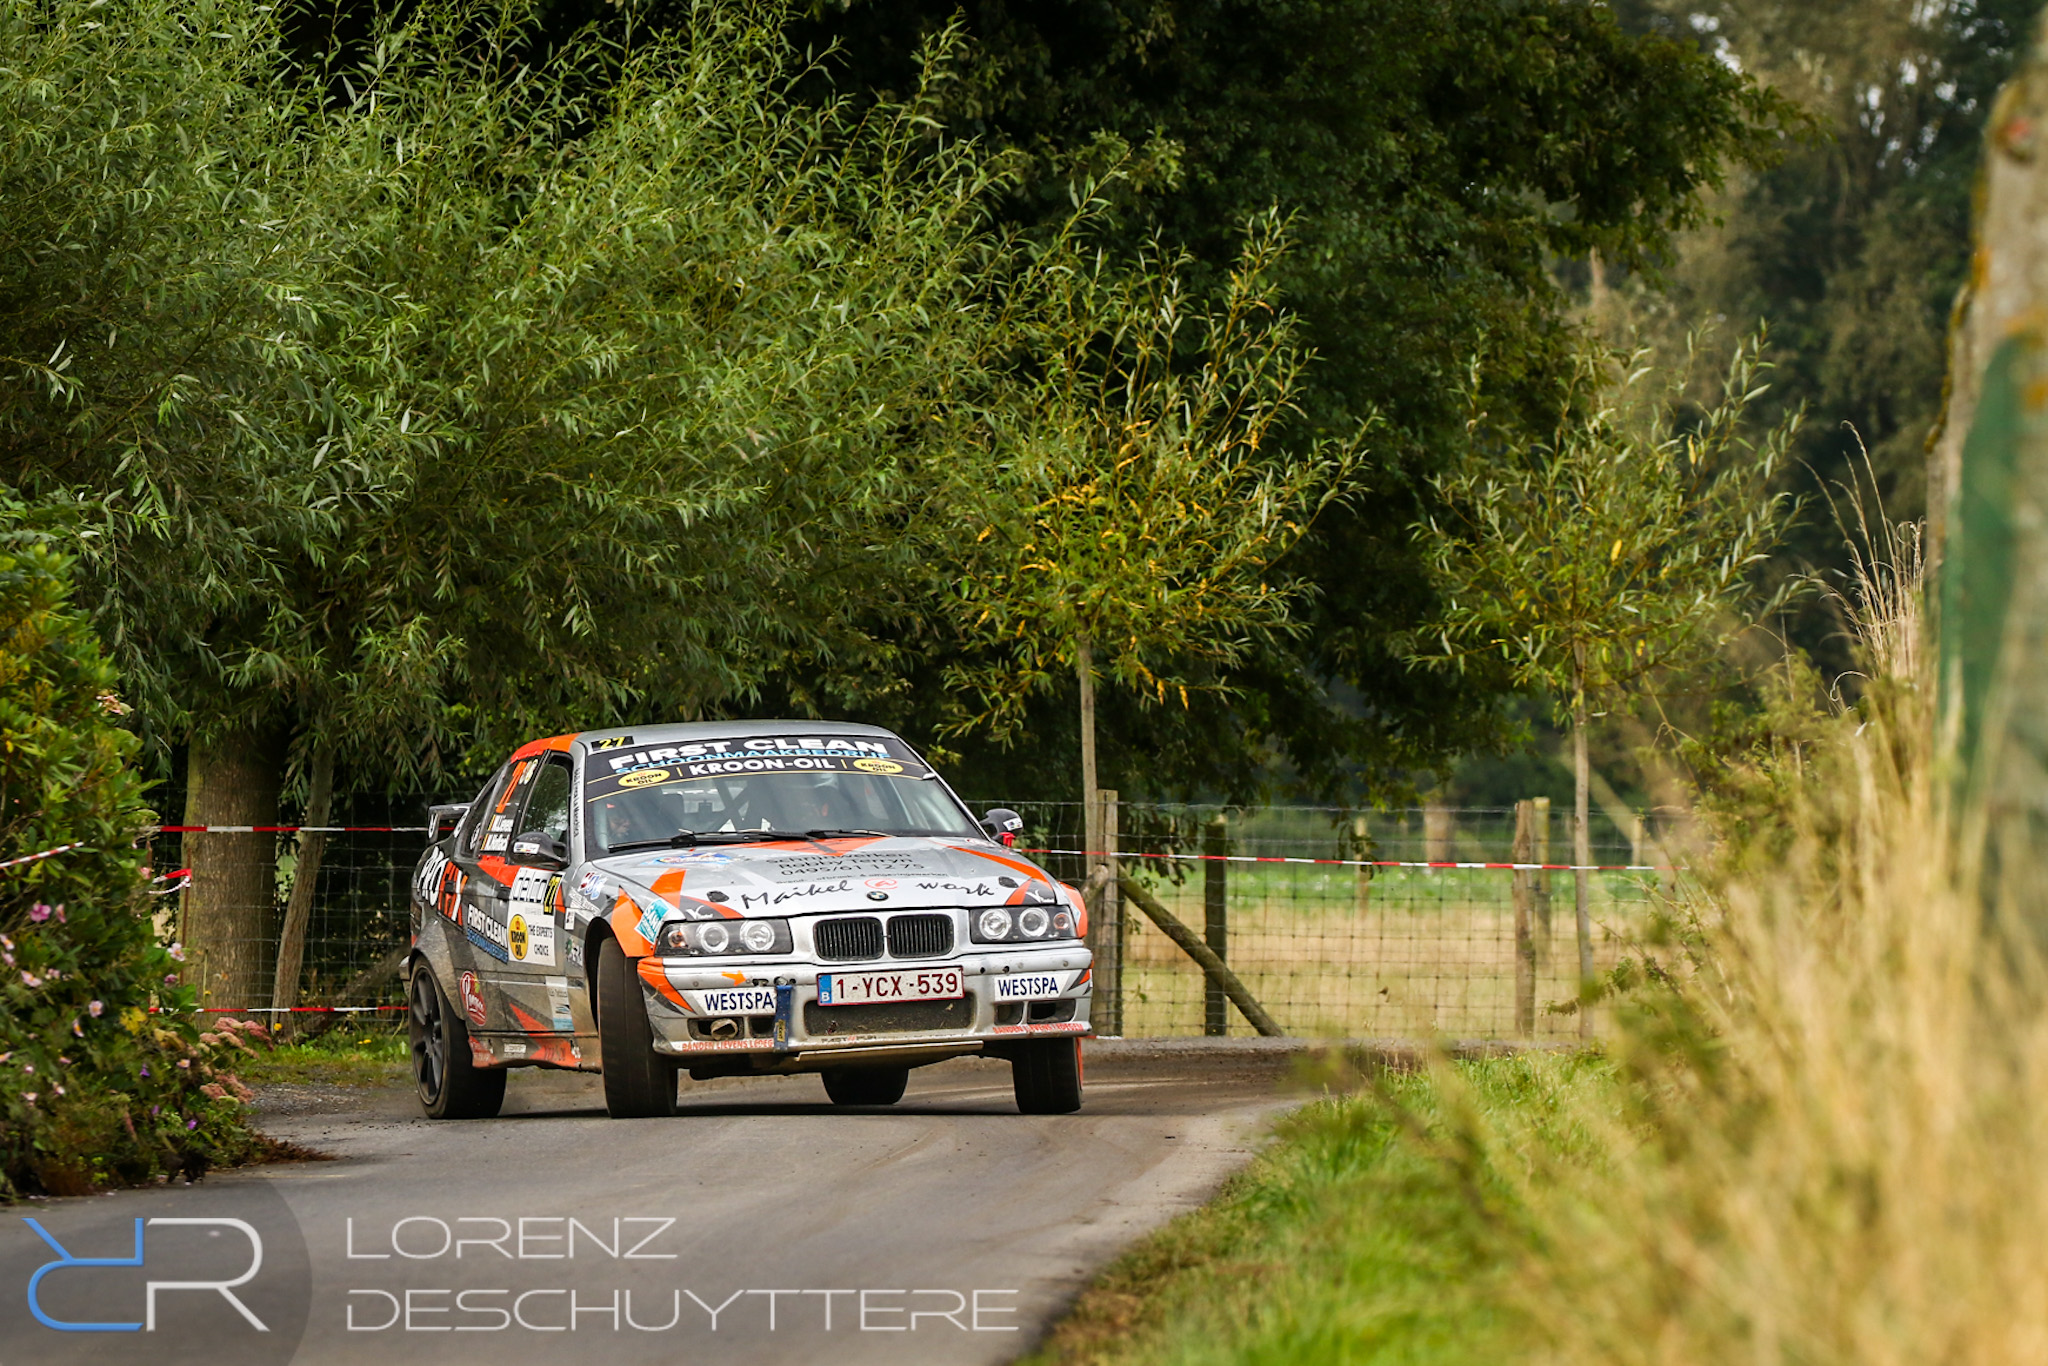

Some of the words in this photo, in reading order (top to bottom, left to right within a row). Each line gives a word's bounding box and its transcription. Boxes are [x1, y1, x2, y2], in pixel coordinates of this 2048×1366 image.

[599, 737, 625, 750] 27
[609, 741, 731, 770] FIRST
[743, 739, 888, 754] CLEAN
[615, 749, 891, 774] SCHOONMAAKBEDRIJF
[689, 758, 836, 777] KROON-OIL
[626, 773, 662, 784] KROON
[467, 903, 486, 934] FIRST
[486, 916, 508, 950] CLEAN
[998, 977, 1059, 997] WESTSPA
[705, 992, 774, 1011] WESTSPA
[821, 992, 830, 1002] B
[682, 1040, 715, 1052] BANDEN
[716, 1039, 748, 1050] LIEVENS
